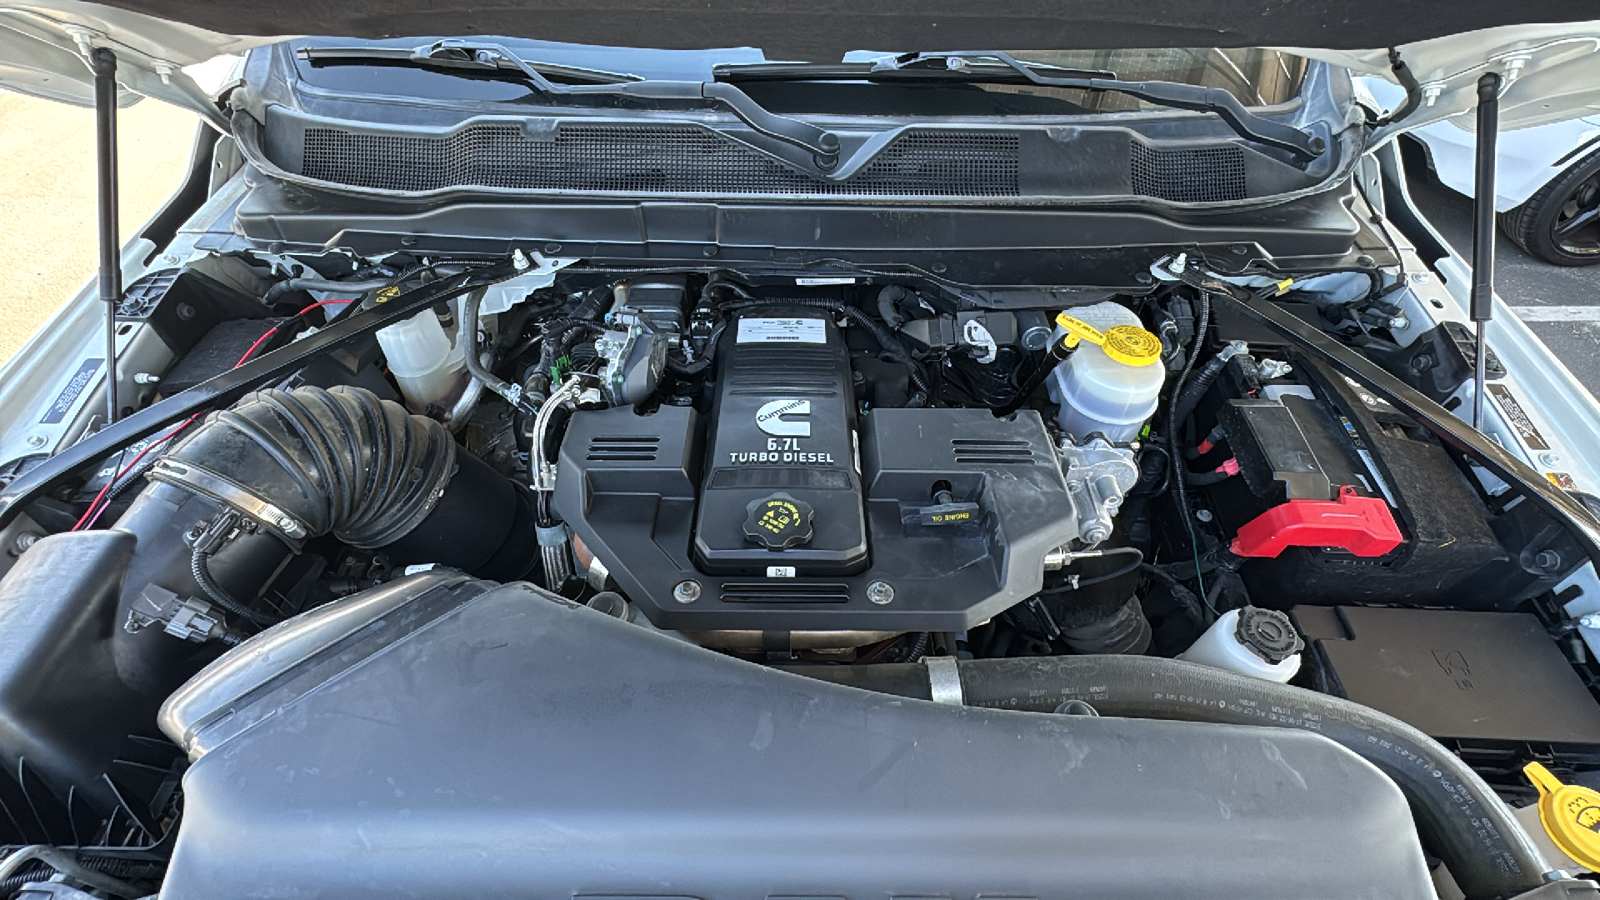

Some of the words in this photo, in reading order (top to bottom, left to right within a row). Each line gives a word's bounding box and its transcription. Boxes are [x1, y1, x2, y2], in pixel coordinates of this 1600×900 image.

[758, 399, 806, 422] Cummins
[767, 438, 801, 451] 6.7L
[729, 452, 779, 463] TURBO
[783, 452, 834, 463] DIESEL
[945, 512, 970, 521] ENGINE
